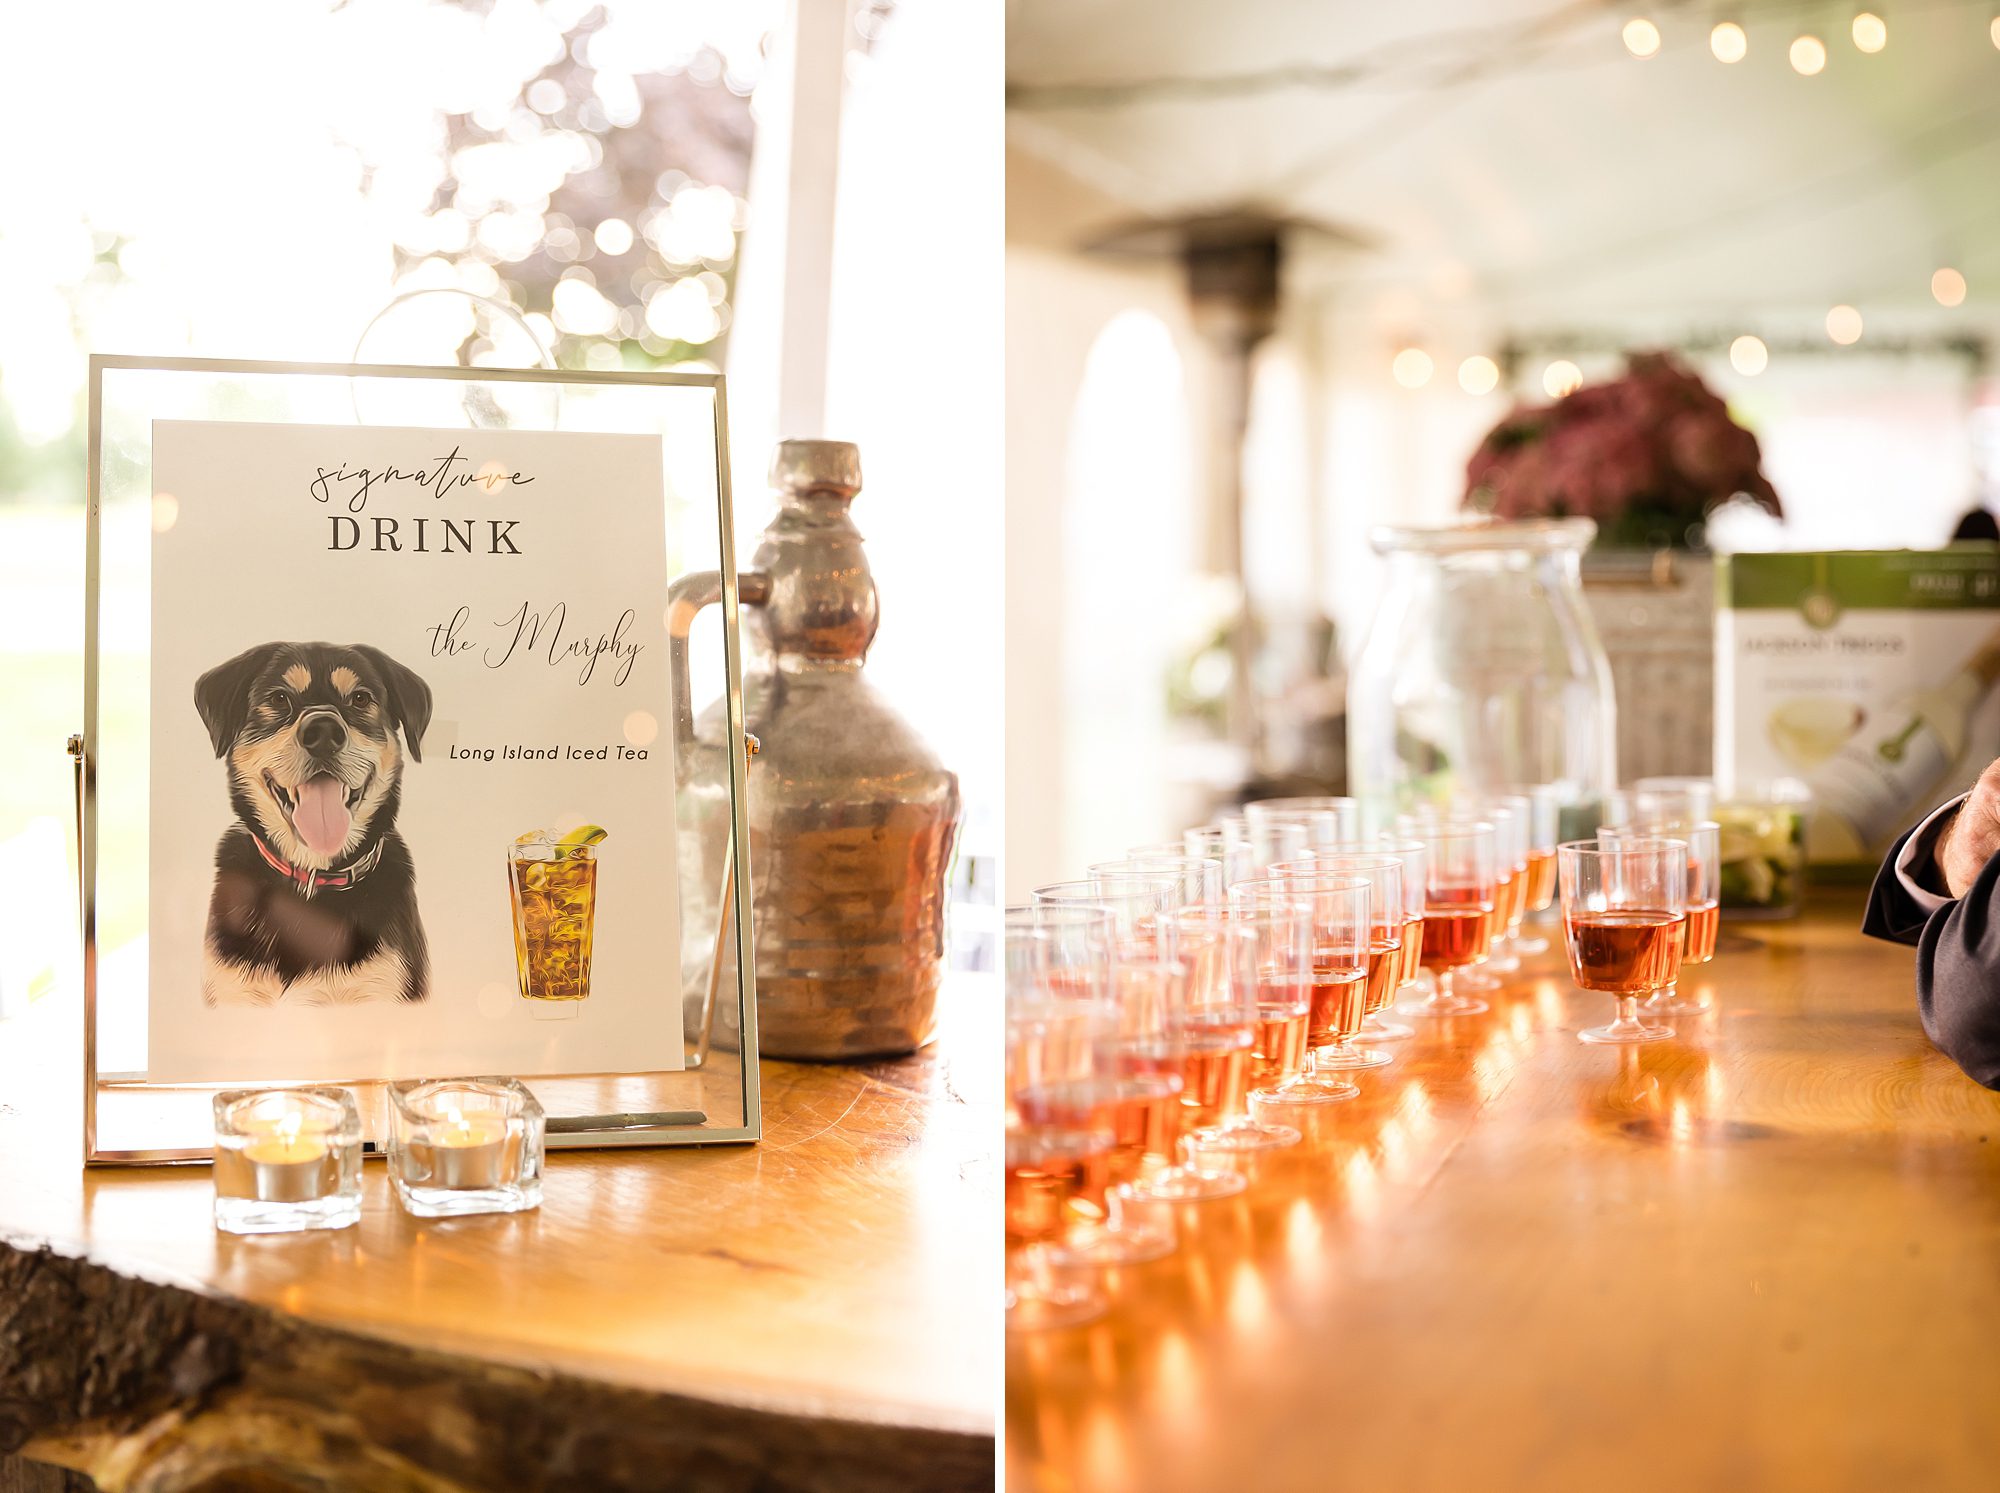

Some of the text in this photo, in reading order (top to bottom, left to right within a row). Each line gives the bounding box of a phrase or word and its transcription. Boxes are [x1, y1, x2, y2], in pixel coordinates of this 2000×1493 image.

[311, 446, 535, 513] signature
[328, 516, 522, 554] DRINK
[426, 601, 645, 687] the Murphy
[450, 745, 648, 761] Long Island Iced Tea
